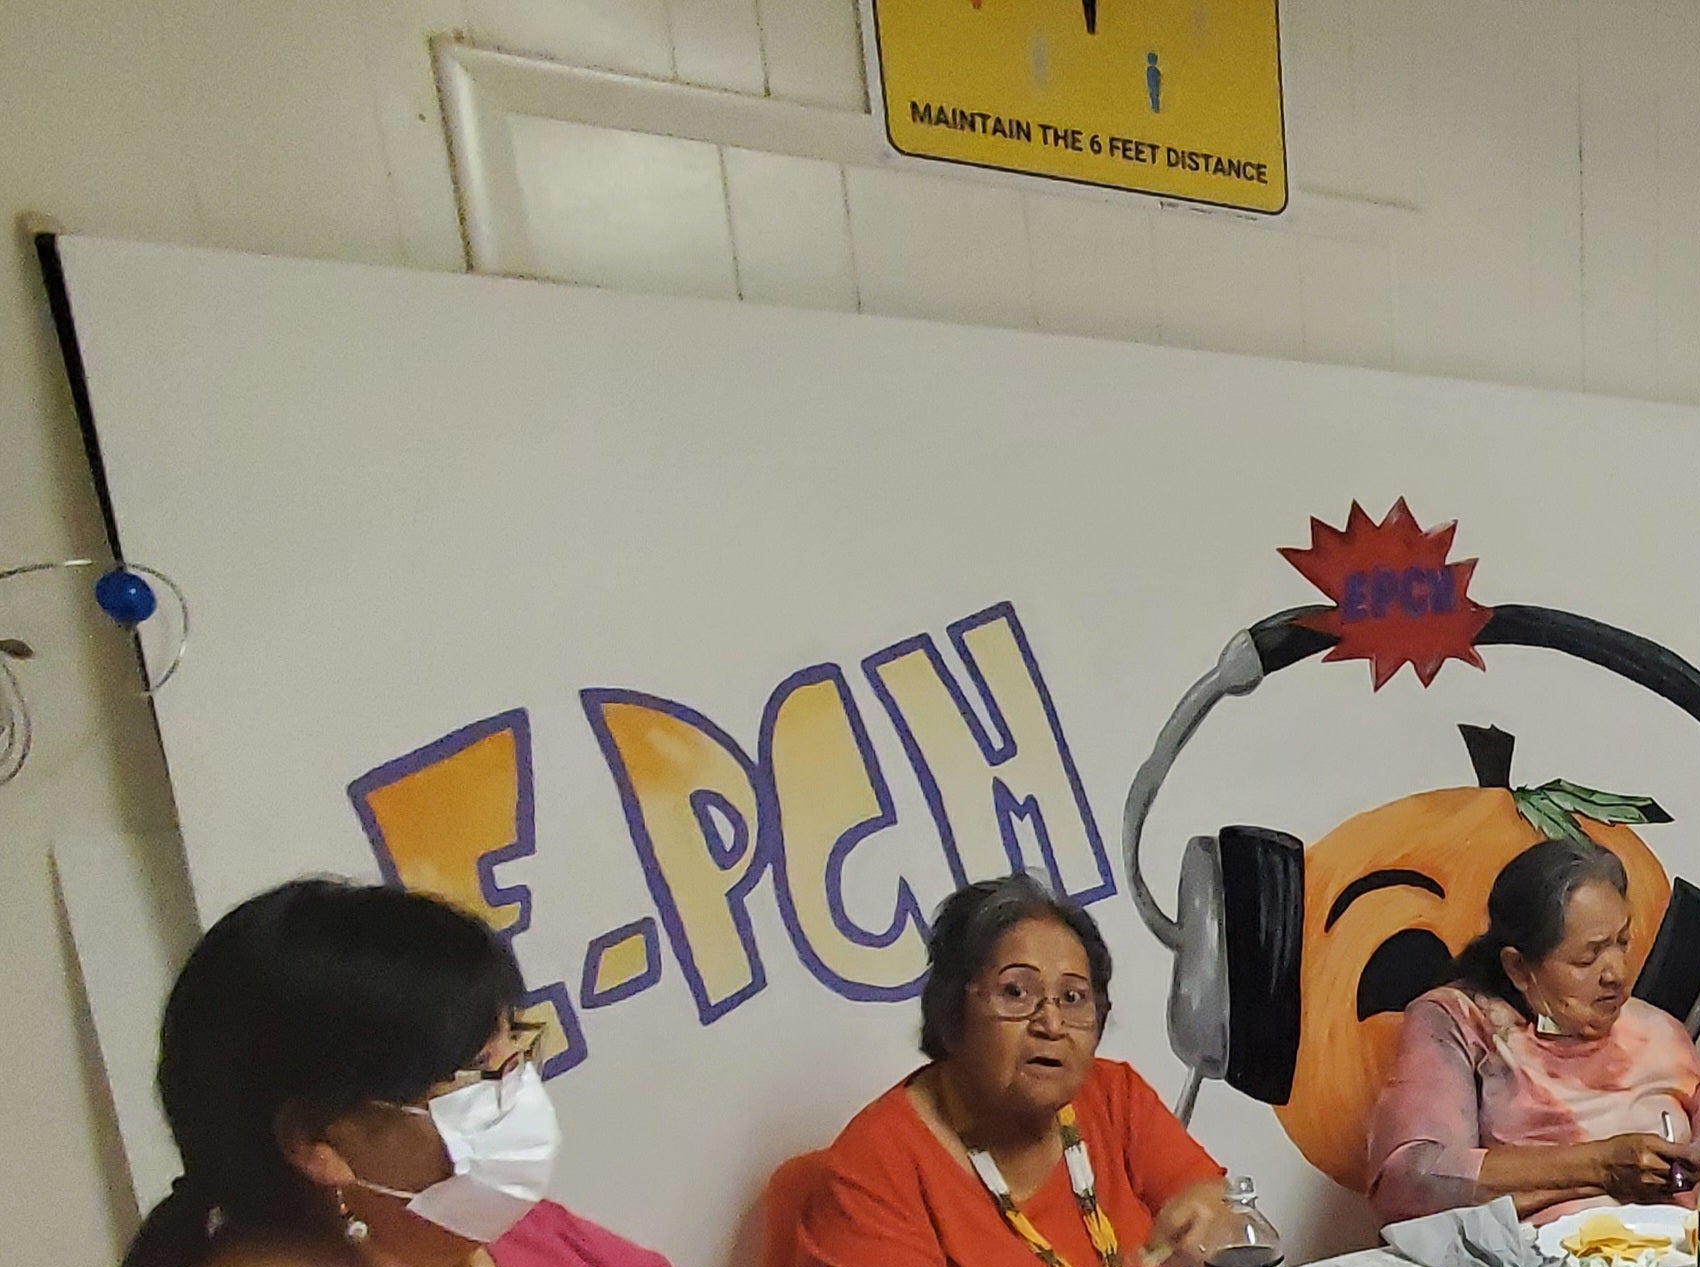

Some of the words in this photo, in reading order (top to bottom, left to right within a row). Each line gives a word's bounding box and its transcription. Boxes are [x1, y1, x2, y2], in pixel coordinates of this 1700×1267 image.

[909, 100, 1032, 143] MAINTAIN
[1038, 123, 1083, 152] THE
[1089, 134, 1102, 155] 6
[1109, 137, 1160, 165] FEET
[1166, 146, 1269, 184] DISTANCE
